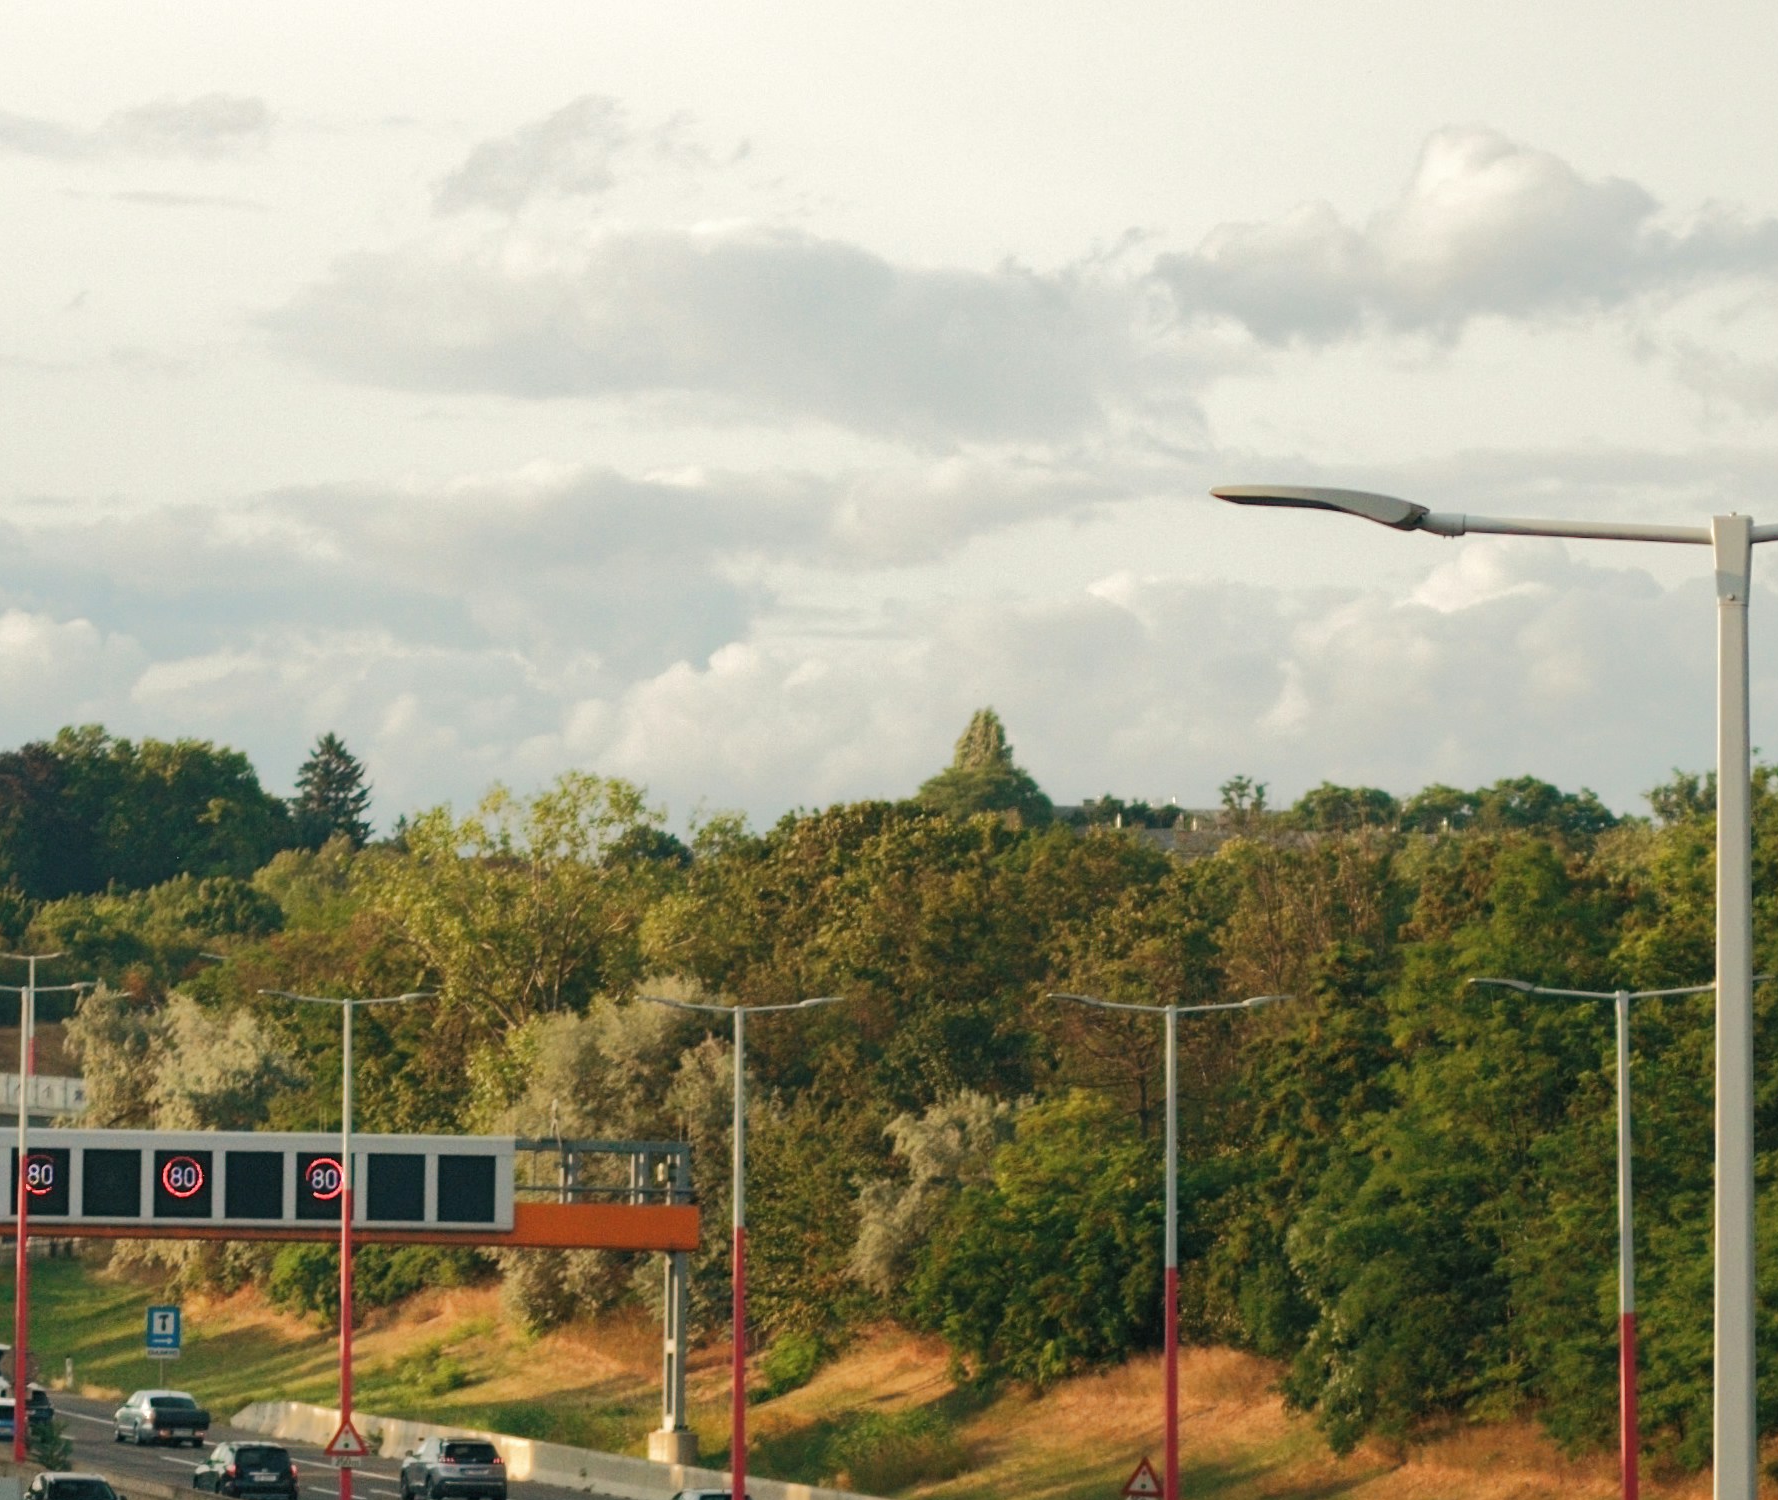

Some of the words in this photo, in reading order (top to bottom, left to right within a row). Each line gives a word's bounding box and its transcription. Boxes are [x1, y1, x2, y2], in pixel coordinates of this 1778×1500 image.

[27, 1164, 54, 1186] 80
[170, 1166, 196, 1188] 80
[311, 1168, 338, 1190] 80
